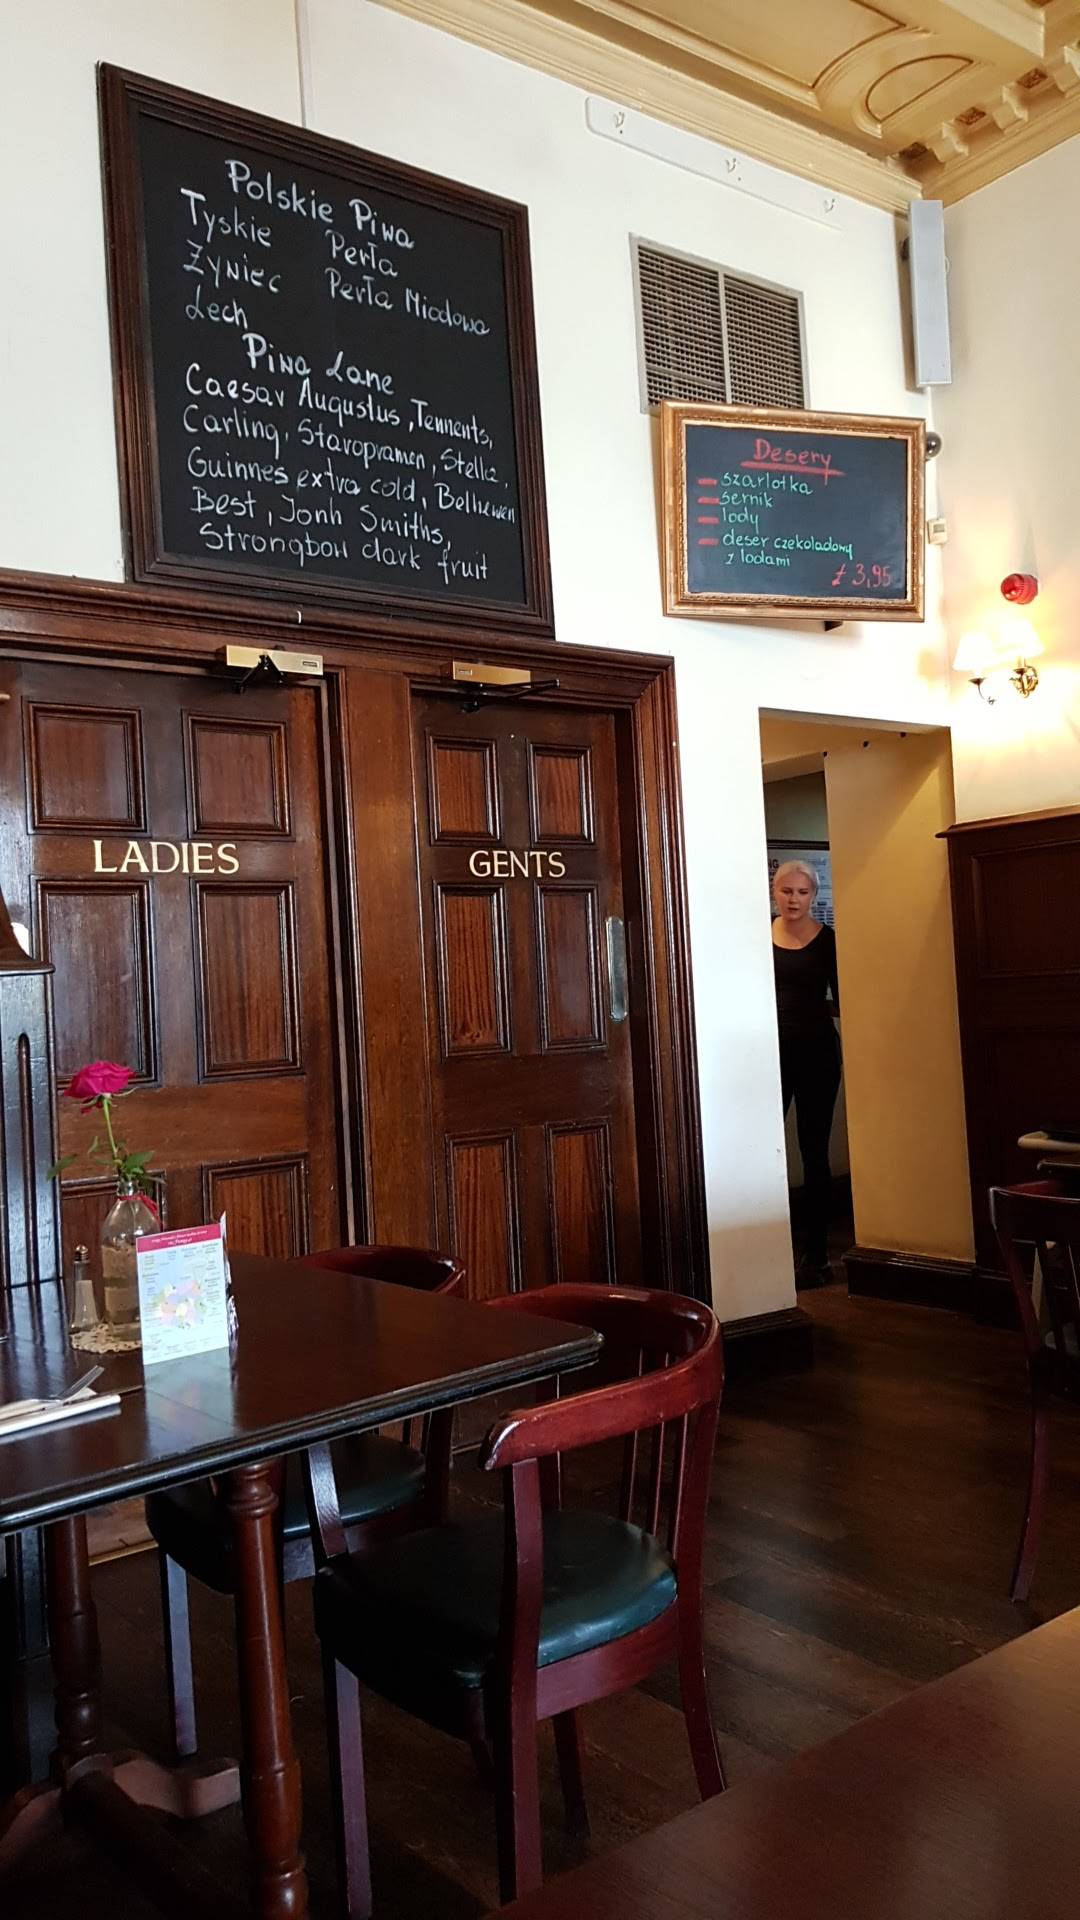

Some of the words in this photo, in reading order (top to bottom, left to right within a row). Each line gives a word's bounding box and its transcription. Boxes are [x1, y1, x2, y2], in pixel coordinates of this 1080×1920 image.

[180, 187, 271, 247] Tyskie
[224, 159, 333, 224] Polskie
[349, 199, 415, 249] Piwa
[185, 284, 248, 330] Lech
[405, 287, 490, 335] Miodowa
[186, 362, 284, 407] Caesar
[326, 350, 394, 395] Lane
[187, 446, 289, 484] Guinnes
[297, 457, 361, 496] extra
[720, 471, 814, 495] szarlotka
[753, 438, 832, 486] Desery
[279, 494, 342, 526] Jonh
[719, 491, 773, 508] sernik
[722, 506, 760, 534] lody
[722, 528, 770, 548] deser
[740, 549, 791, 567] lodami
[362, 537, 421, 570] dark
[437, 549, 489, 585] fruit
[93, 840, 240, 874] LADIES
[469, 850, 566, 878] GENTS
